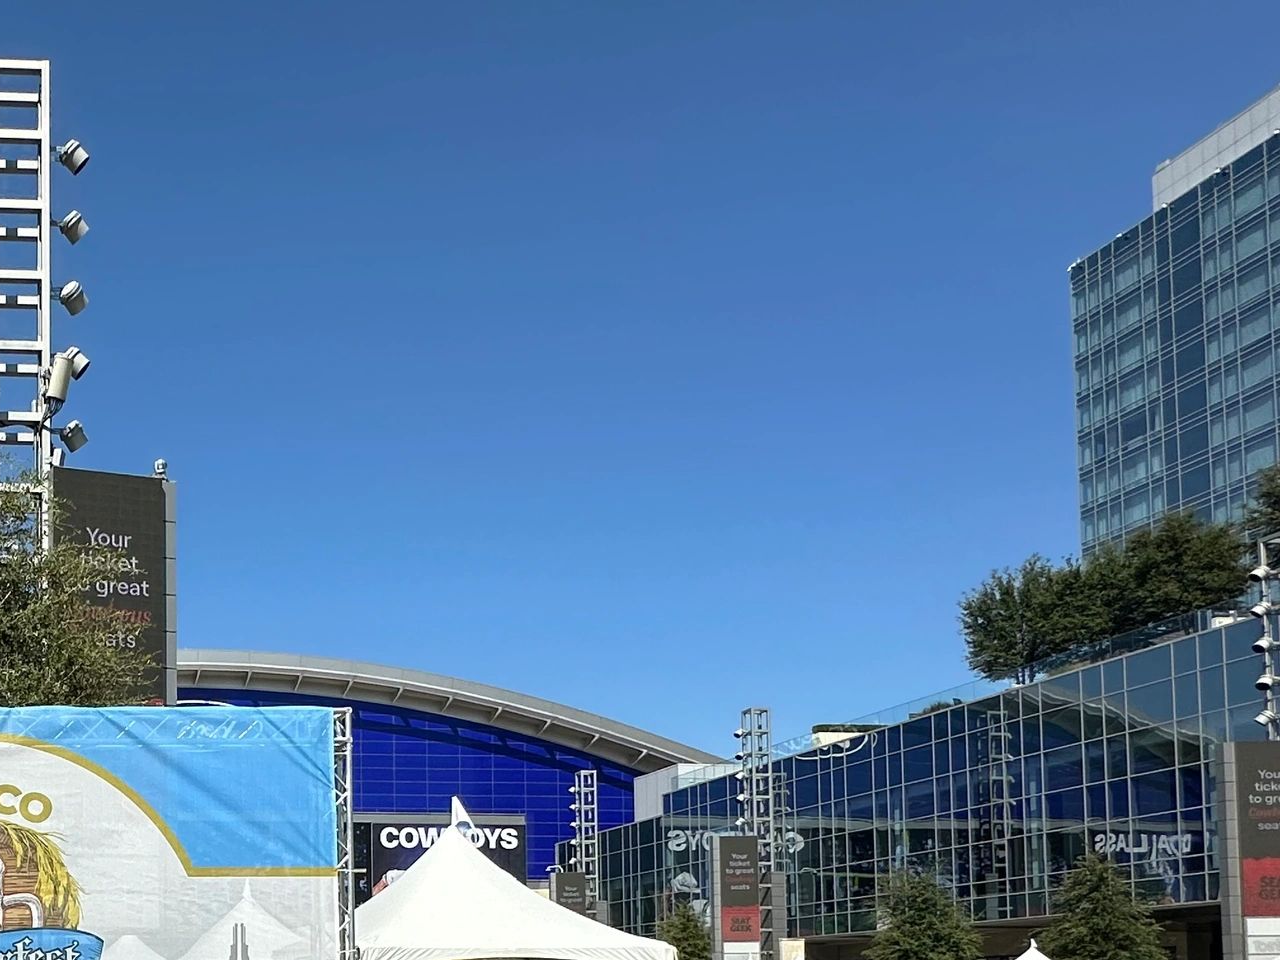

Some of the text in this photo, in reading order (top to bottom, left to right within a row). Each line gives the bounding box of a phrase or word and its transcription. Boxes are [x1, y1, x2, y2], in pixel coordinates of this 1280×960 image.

[86, 527, 132, 548] Your
[95, 579, 150, 597] great
[1257, 769, 1280, 779] You
[1255, 781, 1280, 791] tick
[1248, 794, 1262, 804] to
[379, 826, 519, 850] COWOYS
